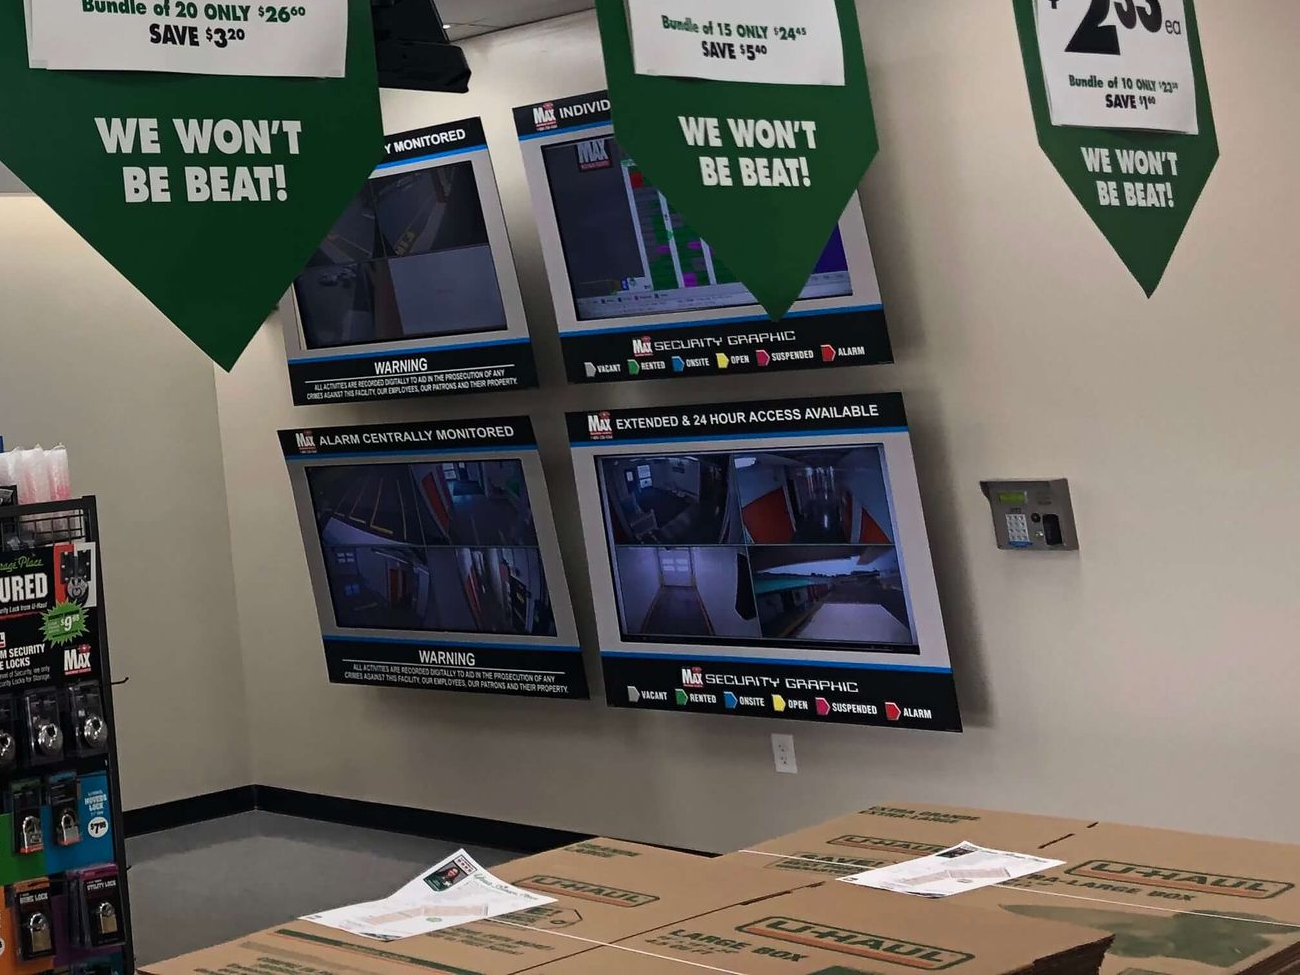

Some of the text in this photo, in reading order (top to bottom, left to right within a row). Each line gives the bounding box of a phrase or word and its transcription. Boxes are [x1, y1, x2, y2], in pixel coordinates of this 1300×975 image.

[154, 0, 170, 16] of
[176, 1, 197, 18] 20
[204, 4, 250, 21] ONLY
[150, 24, 199, 47] SAVE
[661, 15, 698, 33] Bundle
[703, 21, 713, 35] of
[717, 23, 731, 37] 15
[737, 25, 767, 39] ONLY
[1165, 19, 1181, 35] ea
[702, 41, 736, 60] SAVE
[1069, 75, 1156, 91] Bundle of 10 ONLY
[1106, 94, 1136, 109] SAVE
[94, 118, 301, 154] WE WON'T
[394, 129, 465, 152] MONITORED
[678, 116, 816, 148] WE WON'T
[699, 157, 811, 187] BE BEAT!
[1081, 147, 1177, 176] WE WON'T
[122, 164, 287, 202] BE BEAT!
[1097, 181, 1175, 207] BE BEAT!
[374, 358, 428, 375] WARNING
[616, 404, 879, 430] EXTENDED & 24 HOUR ACCESS AVAILABLE
[320, 426, 514, 446] ALARM CENTRALLY MONITORED
[9, 644, 45, 658] SECURITY
[419, 650, 475, 666] WARNING
[6, 657, 30, 669] LOCKS
[705, 674, 858, 693] SECURITY GRAPHIC
[641, 690, 932, 719] VACANT RENTED ONSITE OPEN SUSPENDED ALARM
[670, 930, 807, 962] LARGE BOX
